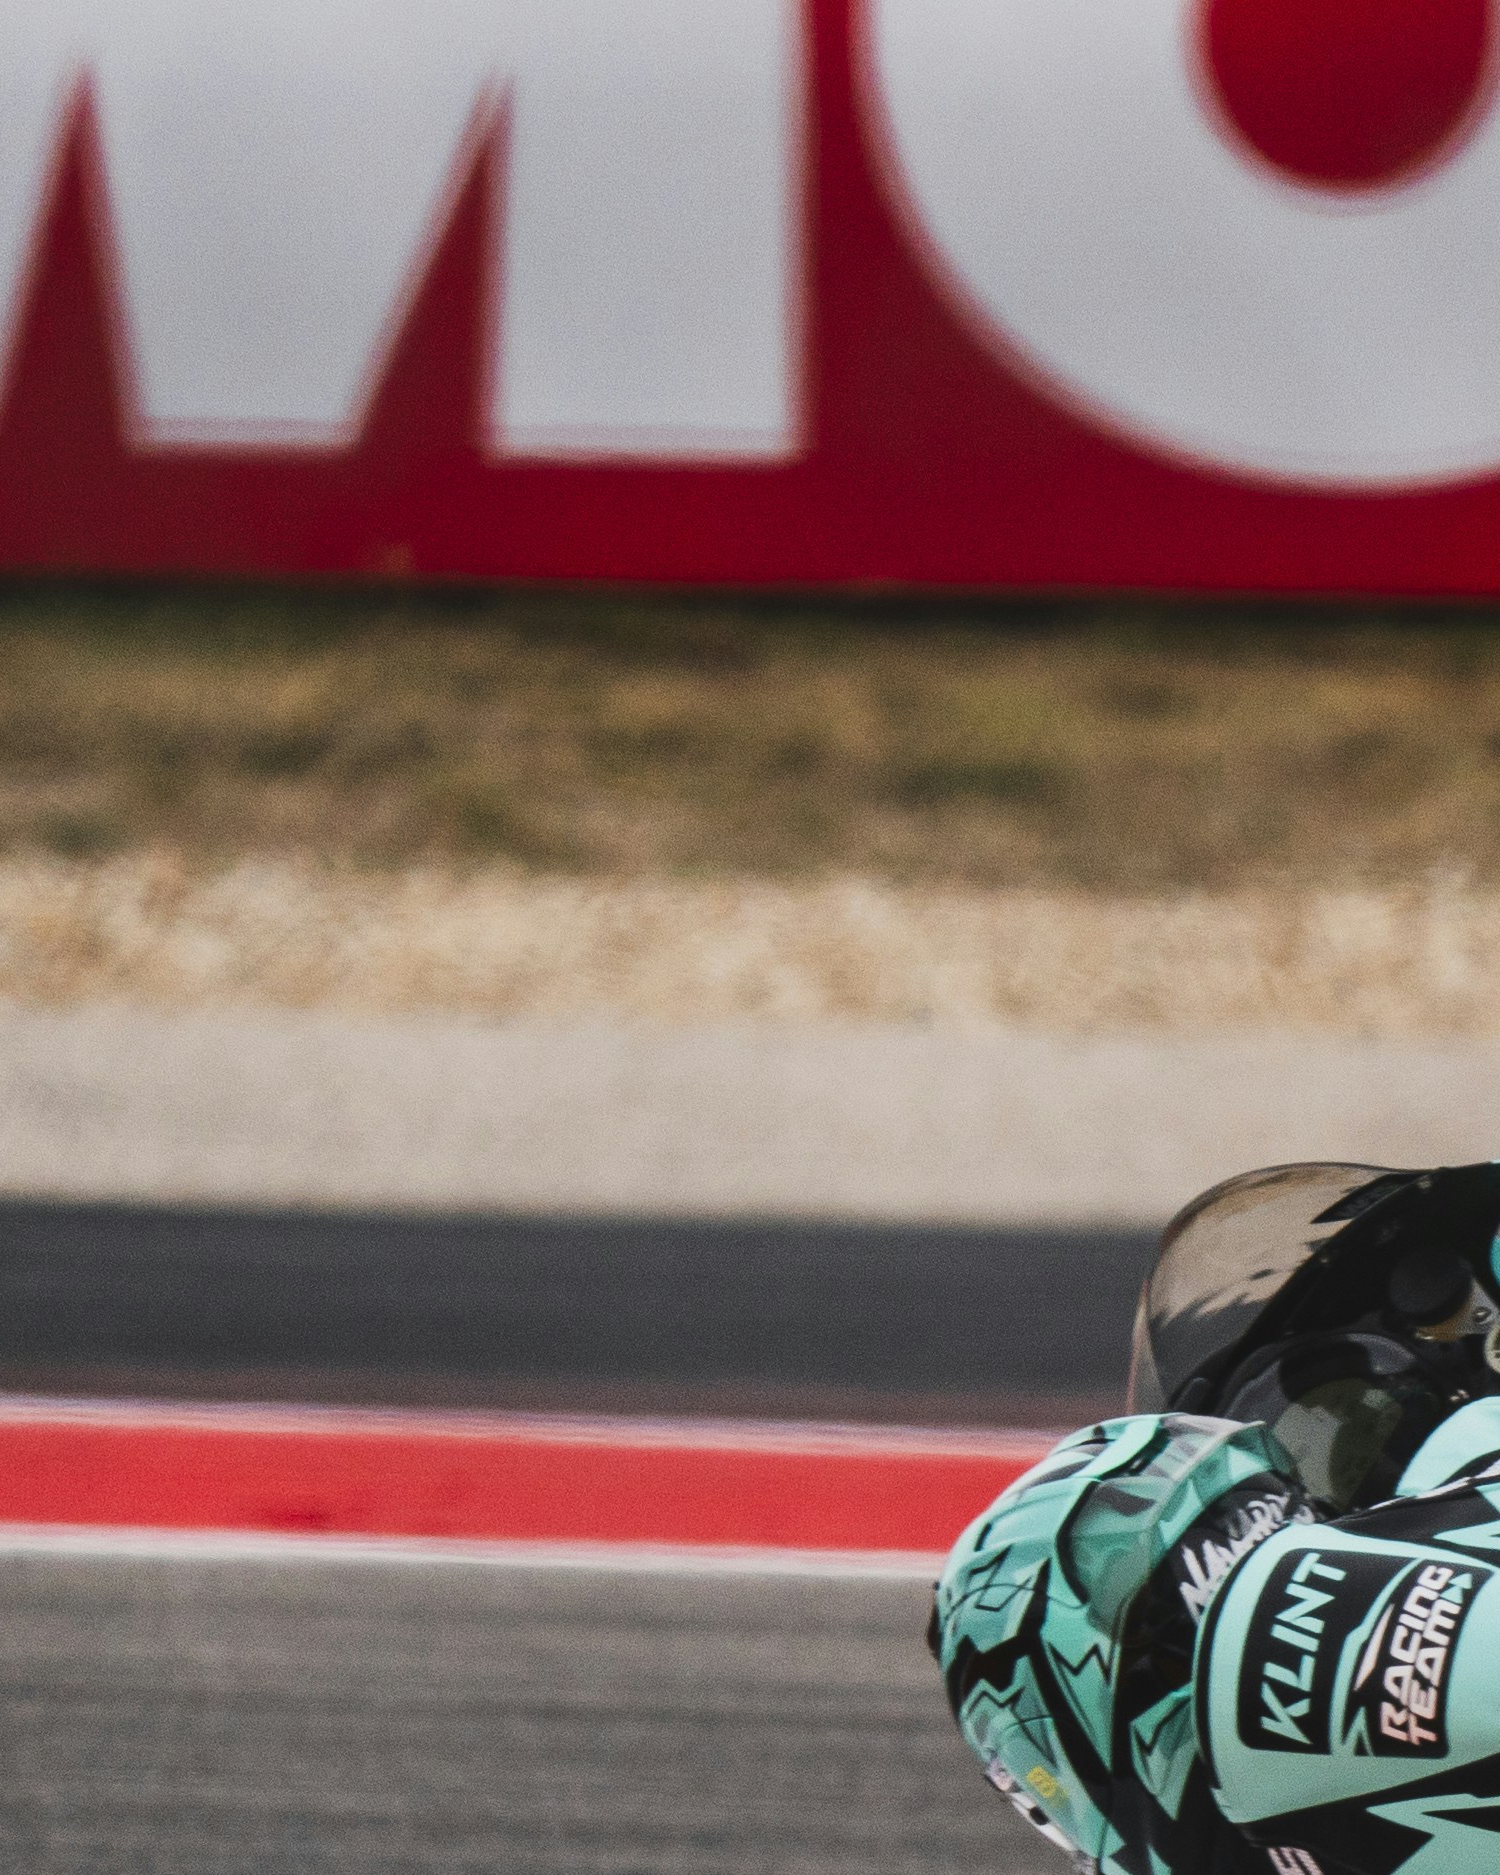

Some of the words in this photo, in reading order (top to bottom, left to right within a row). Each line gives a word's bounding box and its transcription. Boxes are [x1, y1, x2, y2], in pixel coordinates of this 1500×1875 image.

[1260, 1551, 1348, 1746] KLINT
[1379, 1564, 1455, 1743] RACING
[1404, 1595, 1462, 1746] TEAM
